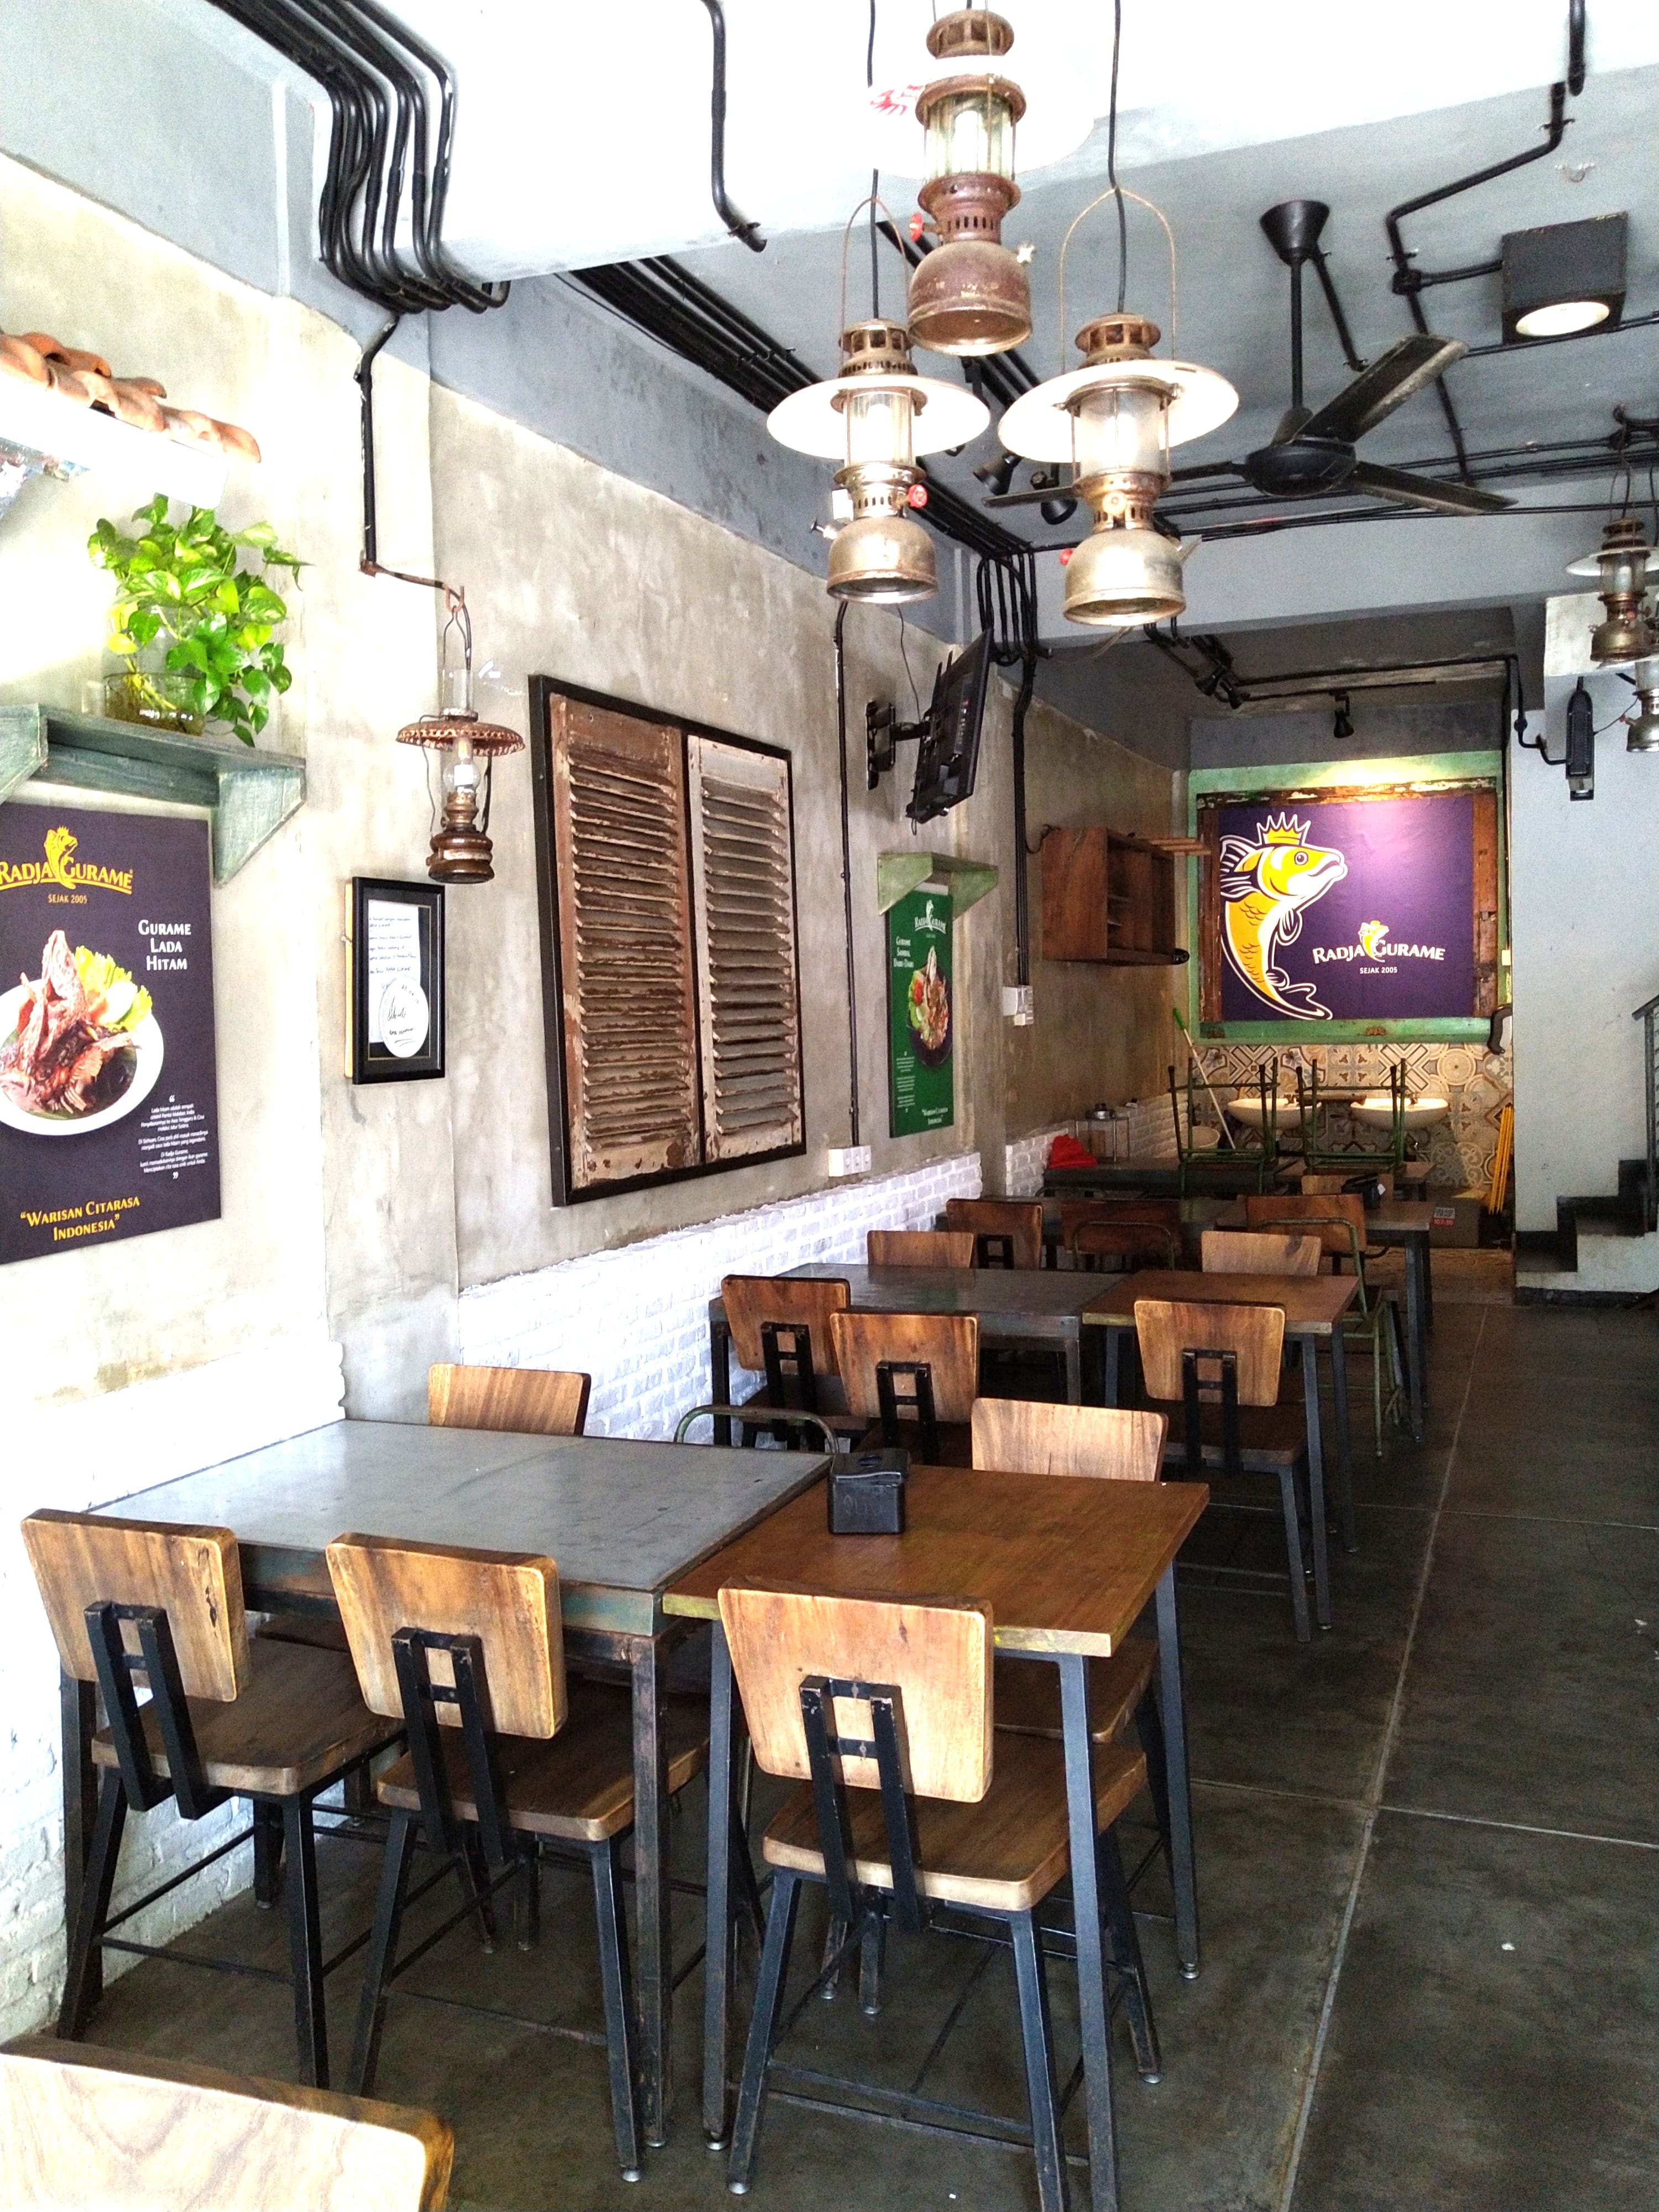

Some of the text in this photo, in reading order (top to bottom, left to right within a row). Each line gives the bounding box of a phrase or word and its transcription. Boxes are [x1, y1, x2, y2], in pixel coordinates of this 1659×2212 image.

[48, 894, 87, 904] SEJAK 2005
[138, 920, 191, 936] GURAME
[150, 938, 182, 953] LADA
[1312, 940, 1446, 964] RADJA GURAME
[147, 956, 187, 971] HITAM
[86, 1196, 140, 1215] CITARASA
